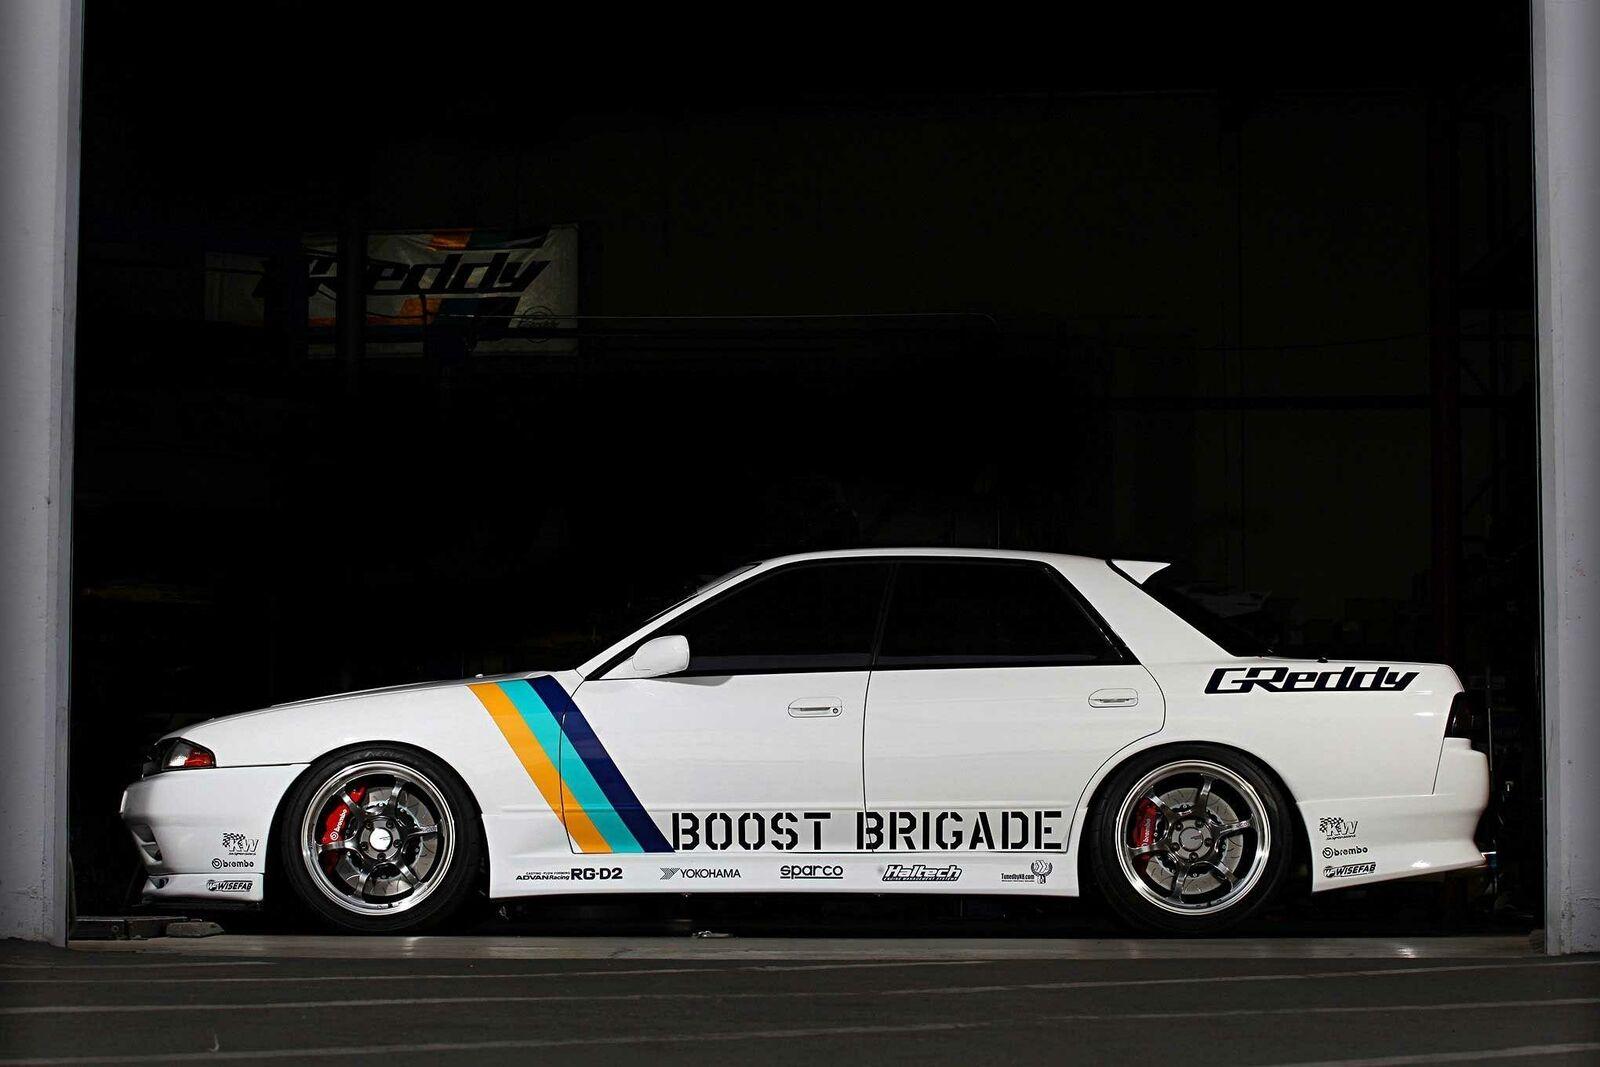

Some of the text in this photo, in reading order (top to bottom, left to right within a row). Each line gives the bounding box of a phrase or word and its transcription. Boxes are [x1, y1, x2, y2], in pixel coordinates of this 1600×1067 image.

[1204, 666, 1420, 694] GReddy
[334, 809, 347, 832] brembo
[672, 810, 1062, 850] BOOST BRIGADE
[1333, 845, 1368, 856] brembo
[223, 859, 254, 868] brembo
[1336, 863, 1376, 876] WISEFAB
[570, 867, 623, 880] RG-D2
[680, 868, 741, 878] YOKOHAMA
[780, 865, 843, 879] sparco
[884, 865, 962, 878] Haltech
[217, 881, 253, 890] WISEFAB
